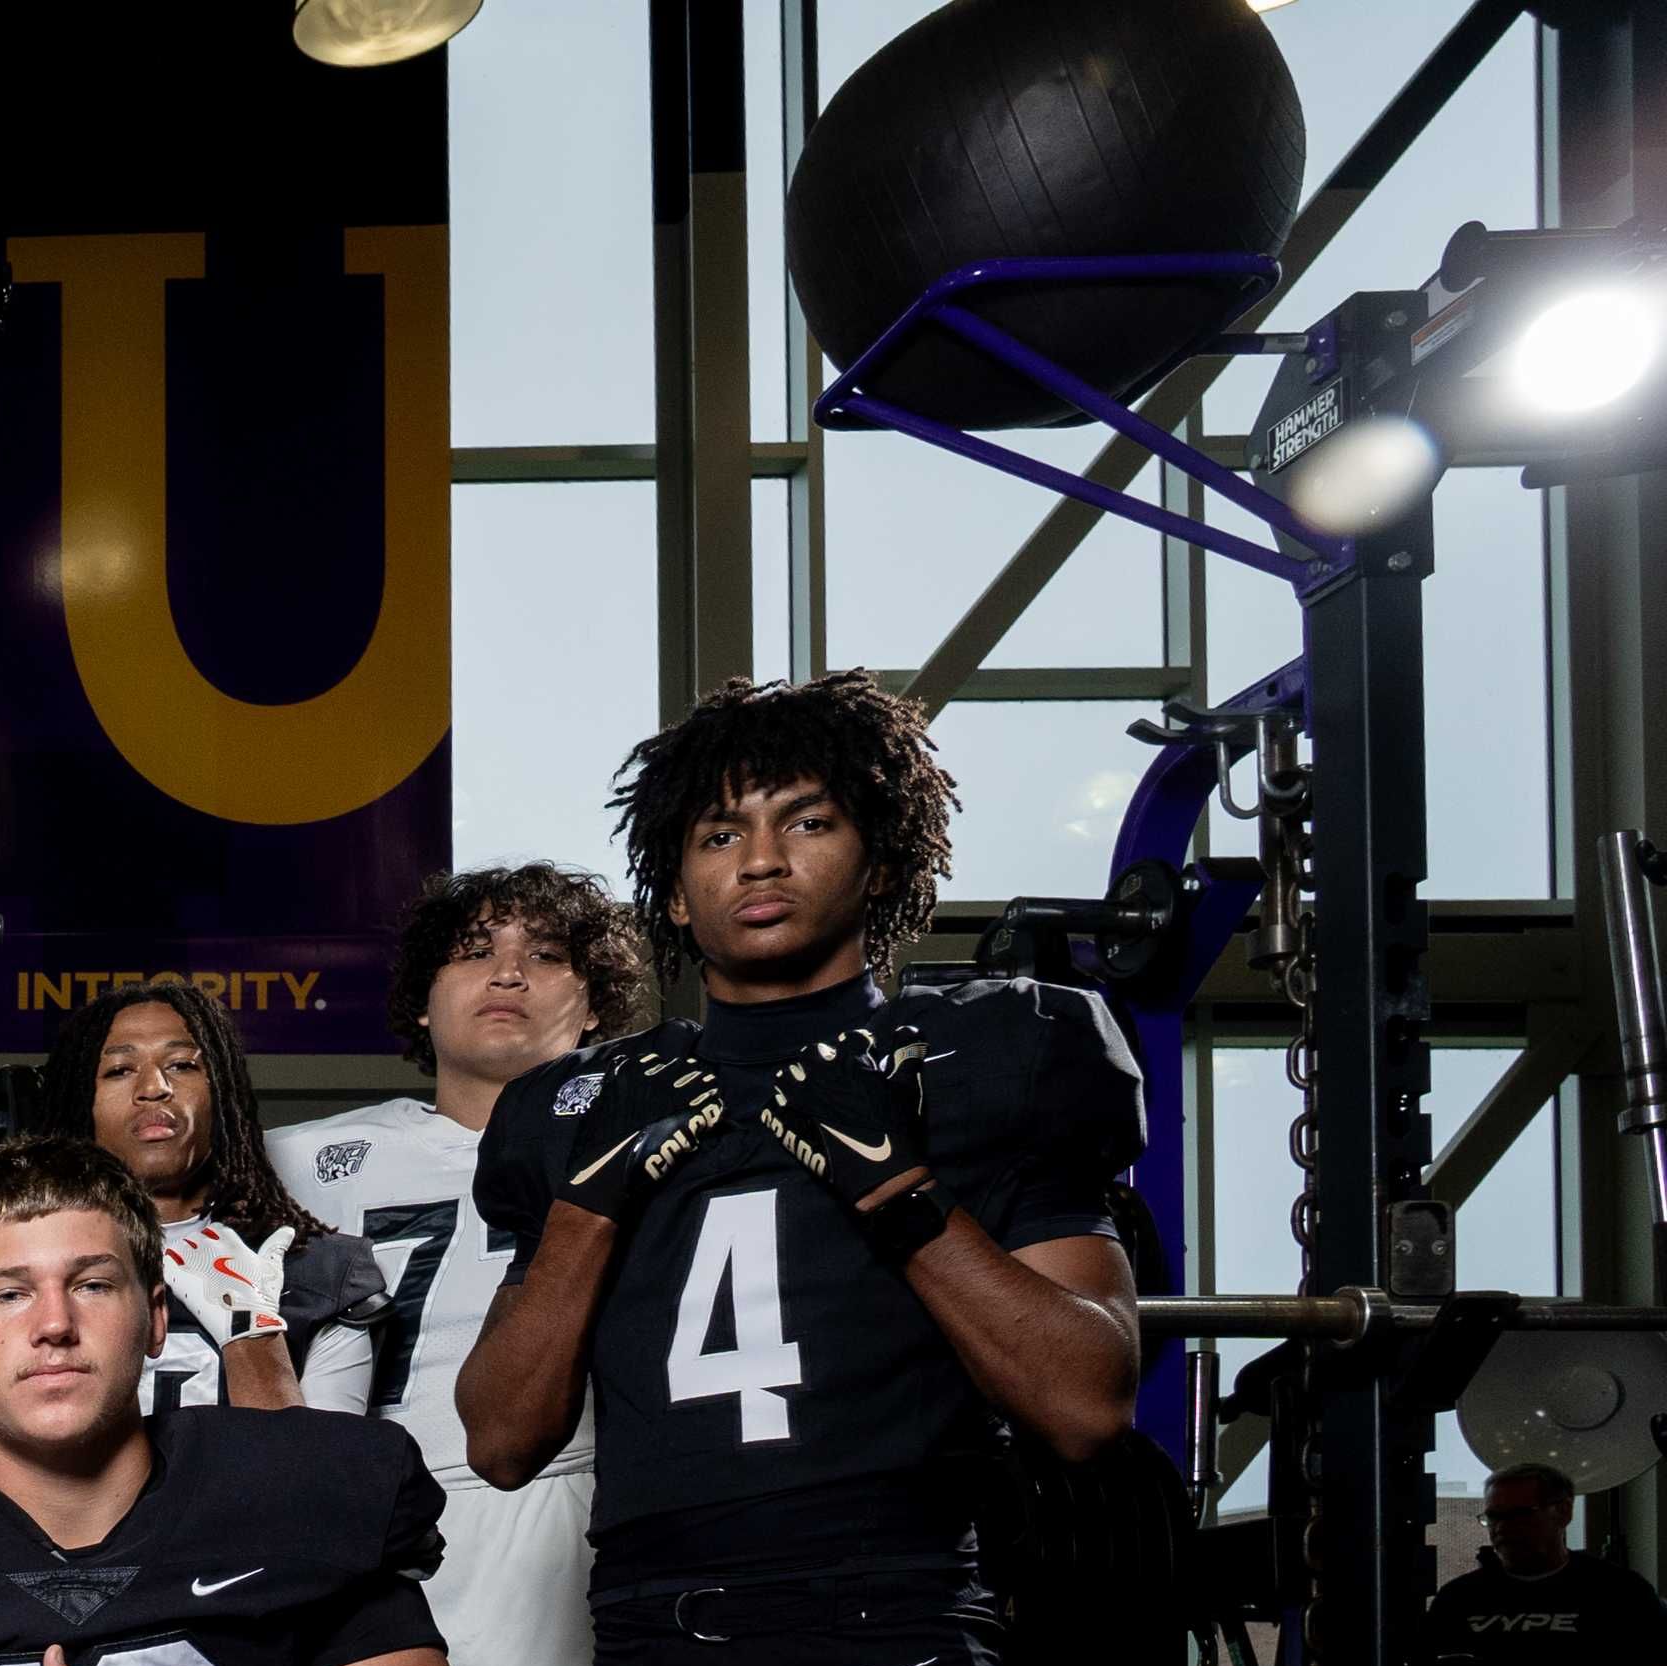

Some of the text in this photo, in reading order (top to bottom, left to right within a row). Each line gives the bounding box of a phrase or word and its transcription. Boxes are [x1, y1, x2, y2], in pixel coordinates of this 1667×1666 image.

[1272, 405, 1339, 468] STRENGTH
[1275, 387, 1336, 447] HAMMER
[5, 225, 452, 825] U
[669, 1189, 802, 1444] 4
